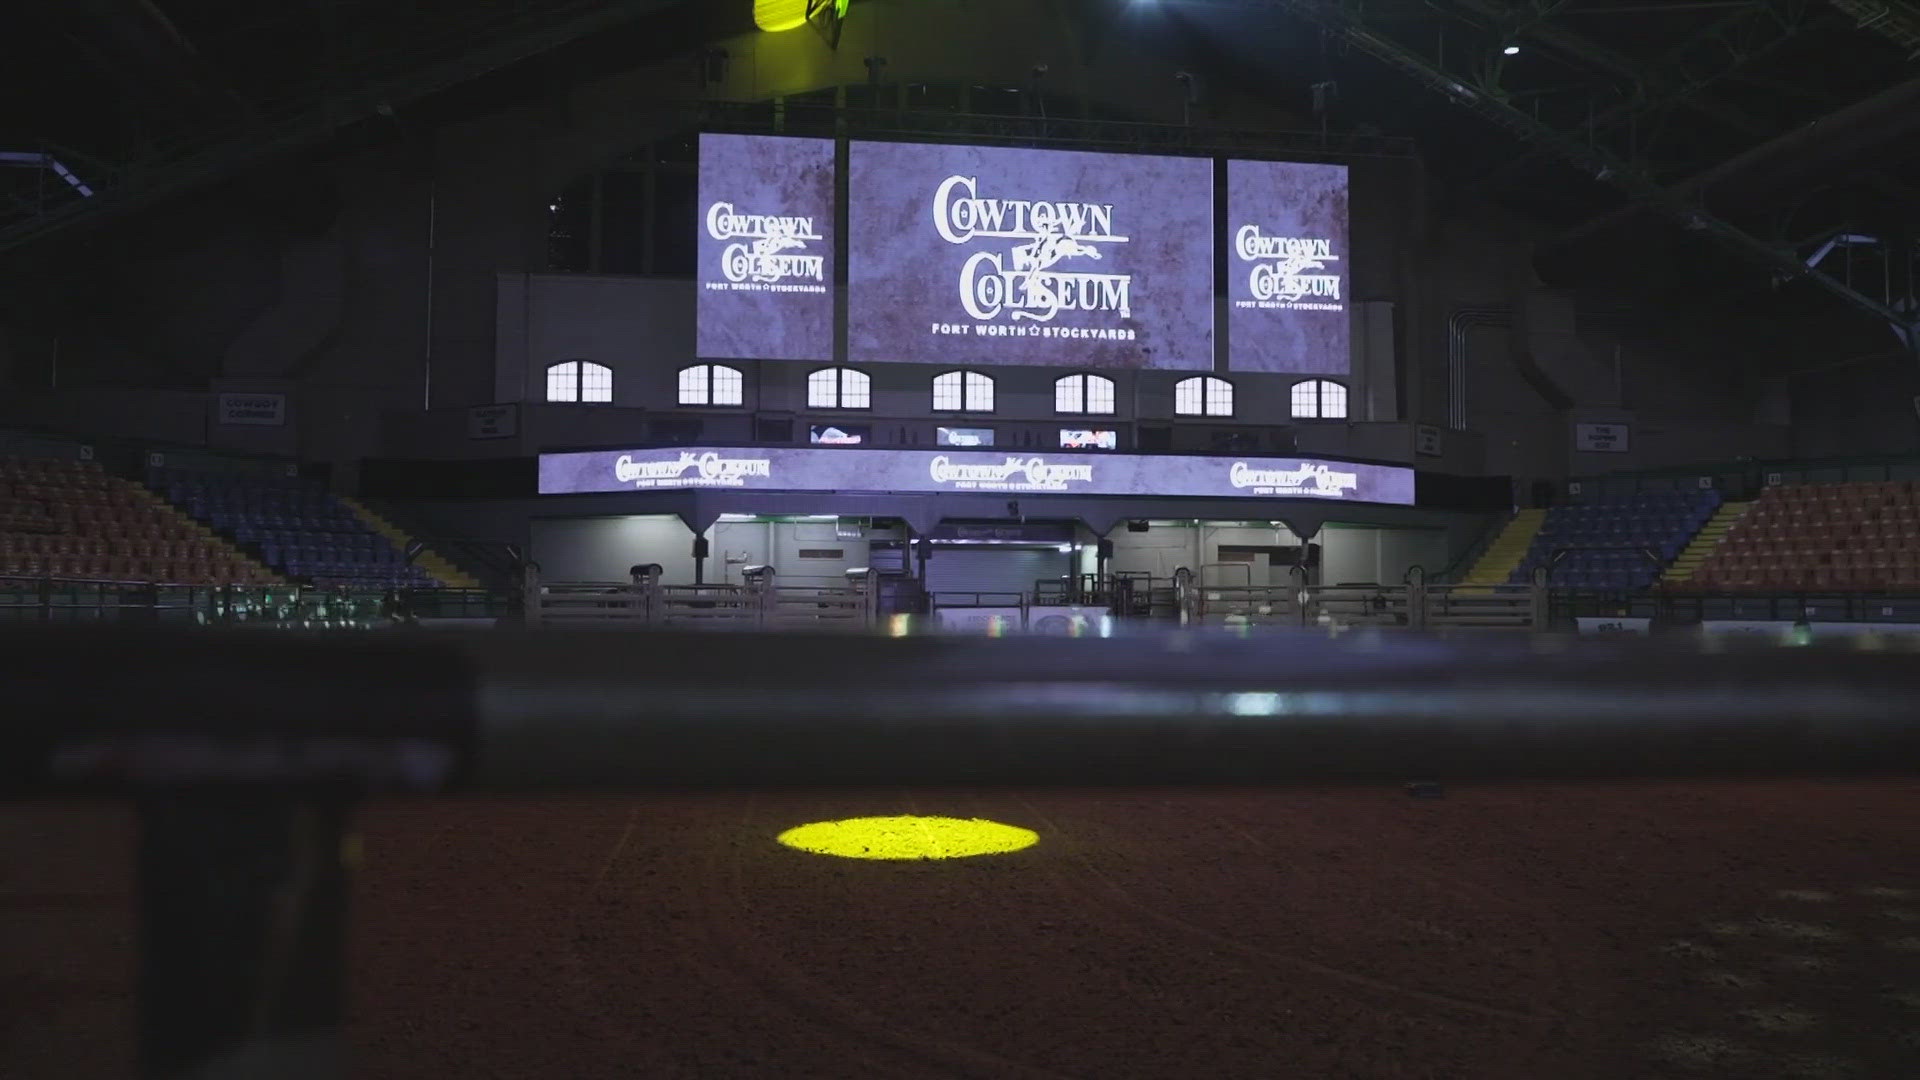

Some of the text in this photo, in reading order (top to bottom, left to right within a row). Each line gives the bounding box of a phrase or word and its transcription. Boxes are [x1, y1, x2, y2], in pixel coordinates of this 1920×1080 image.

[706, 201, 814, 240] COWTOWN
[933, 175, 1114, 244] COWTOWN
[722, 243, 824, 282] COLISEUM
[1235, 225, 1331, 261] COWTOWN
[959, 251, 1131, 322] COLISEUM
[932, 323, 1136, 340] FORT WORTH STOCKYARDS
